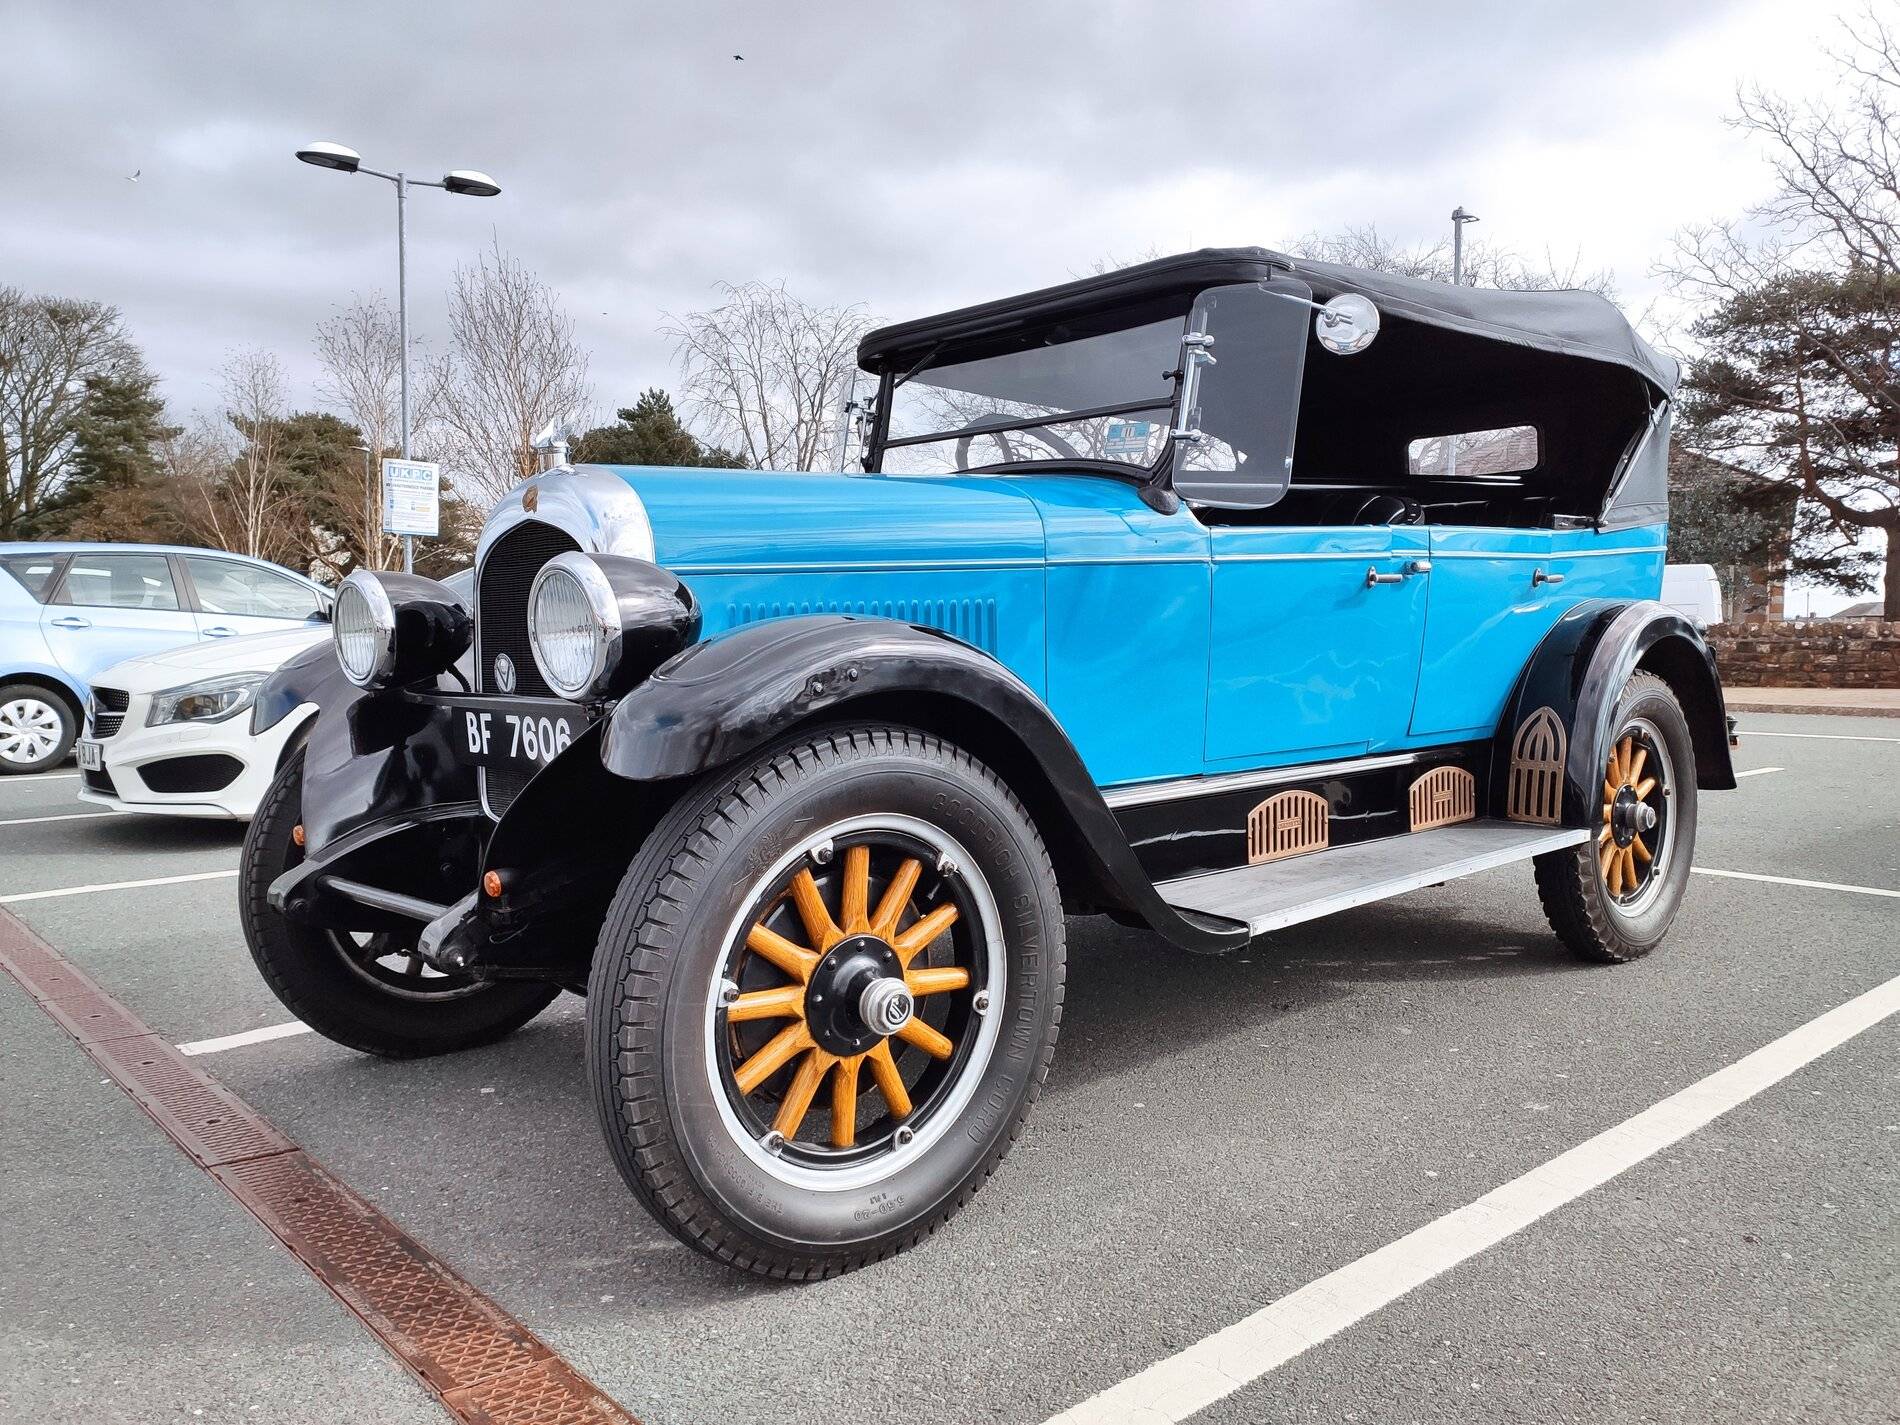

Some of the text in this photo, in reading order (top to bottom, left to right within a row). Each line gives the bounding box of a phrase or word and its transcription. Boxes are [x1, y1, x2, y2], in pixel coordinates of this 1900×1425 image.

[466, 711, 572, 763] BF 7606
[932, 792, 1039, 1145] GOODRICH SILVERTOWN CORD
